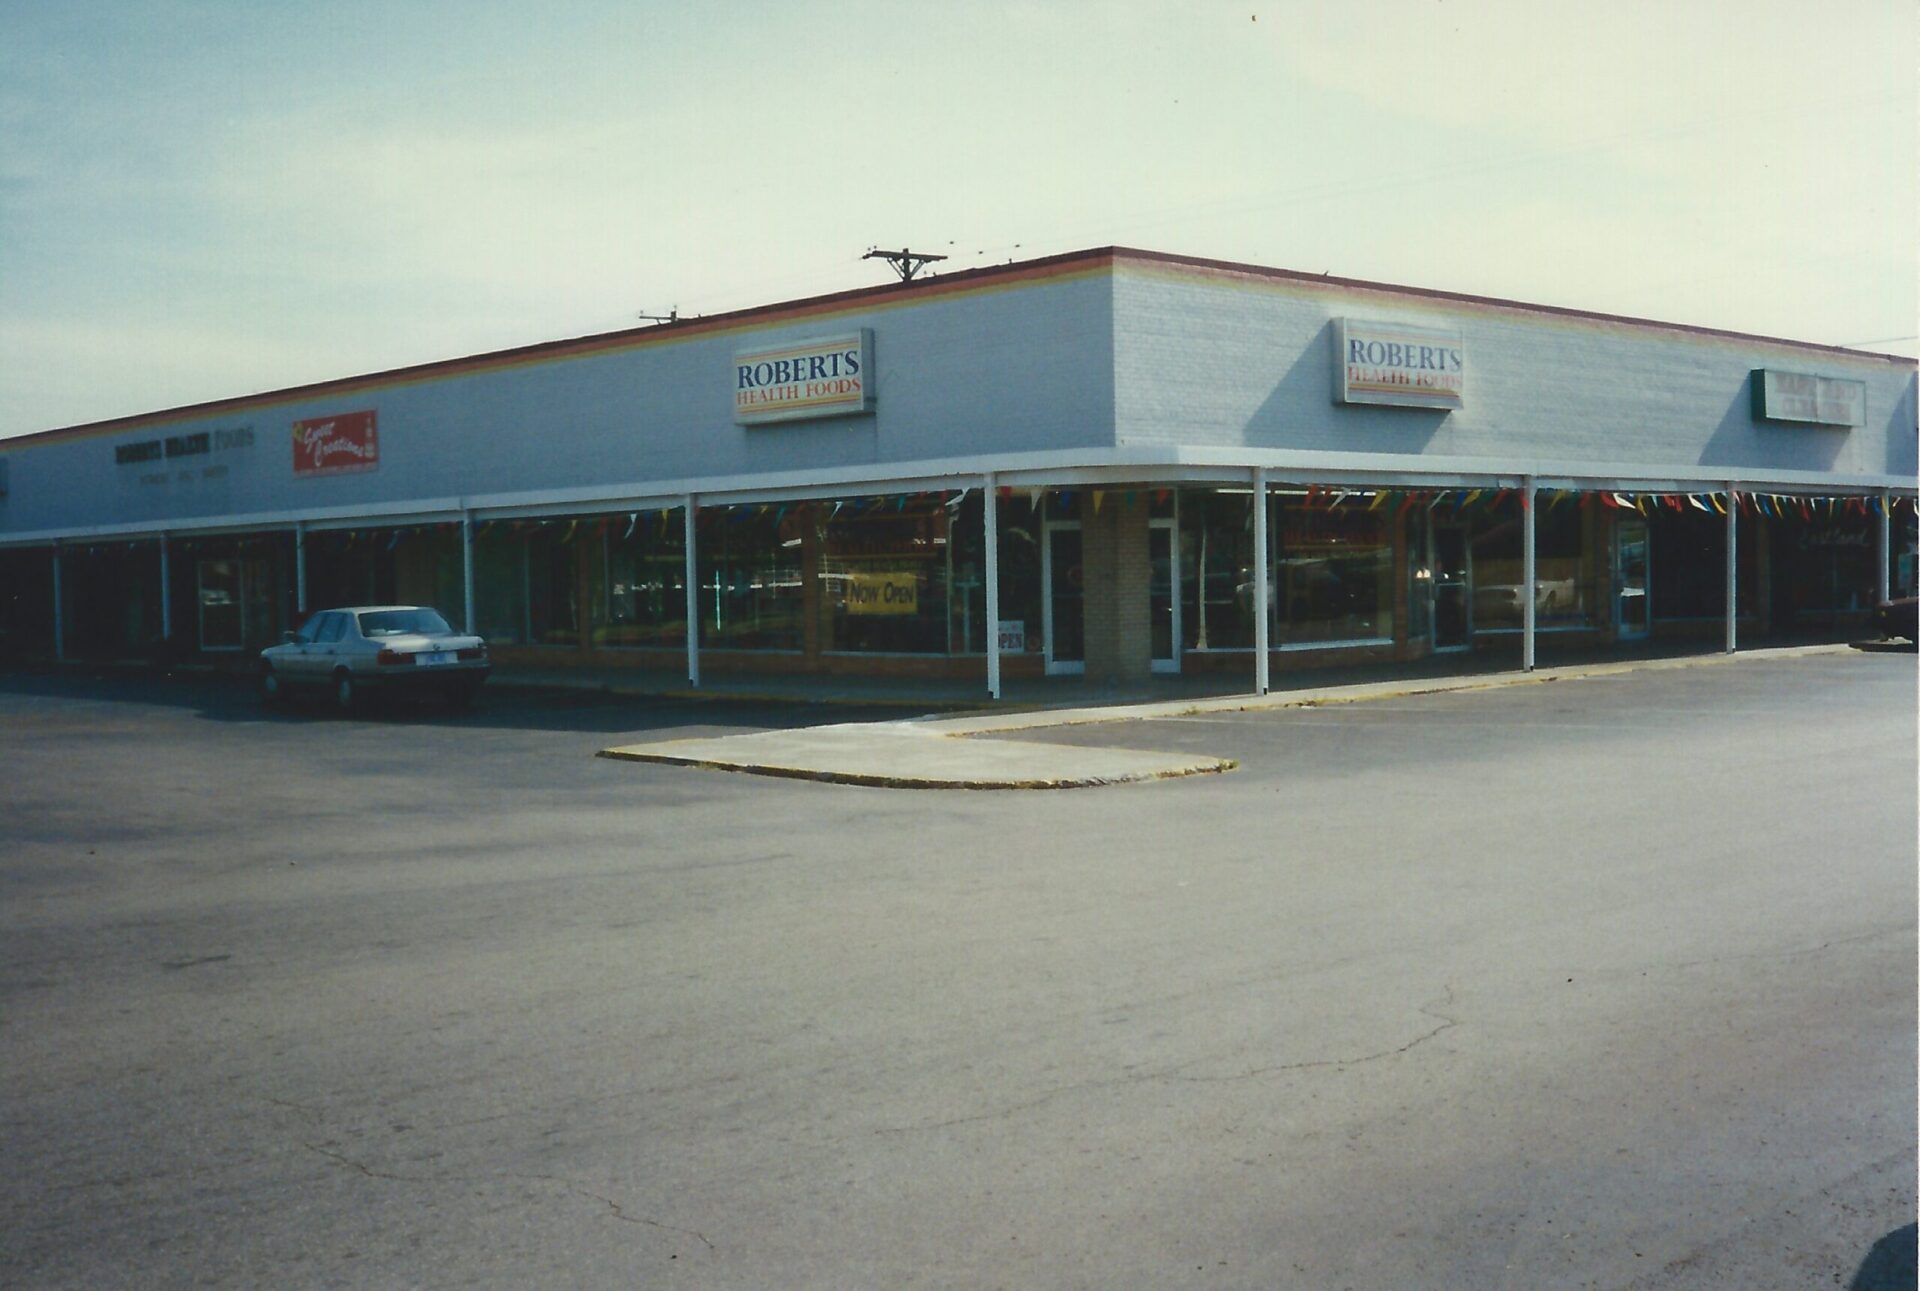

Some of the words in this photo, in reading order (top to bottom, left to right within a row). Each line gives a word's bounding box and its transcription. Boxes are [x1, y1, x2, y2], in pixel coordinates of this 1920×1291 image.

[737, 350, 860, 389] ROBERTS
[1349, 339, 1462, 373] ROBERTS
[1348, 366, 1411, 385] HEALTH
[736, 384, 799, 405] HEALTH
[806, 376, 861, 398] FOODS
[997, 632, 1023, 650] PEN
